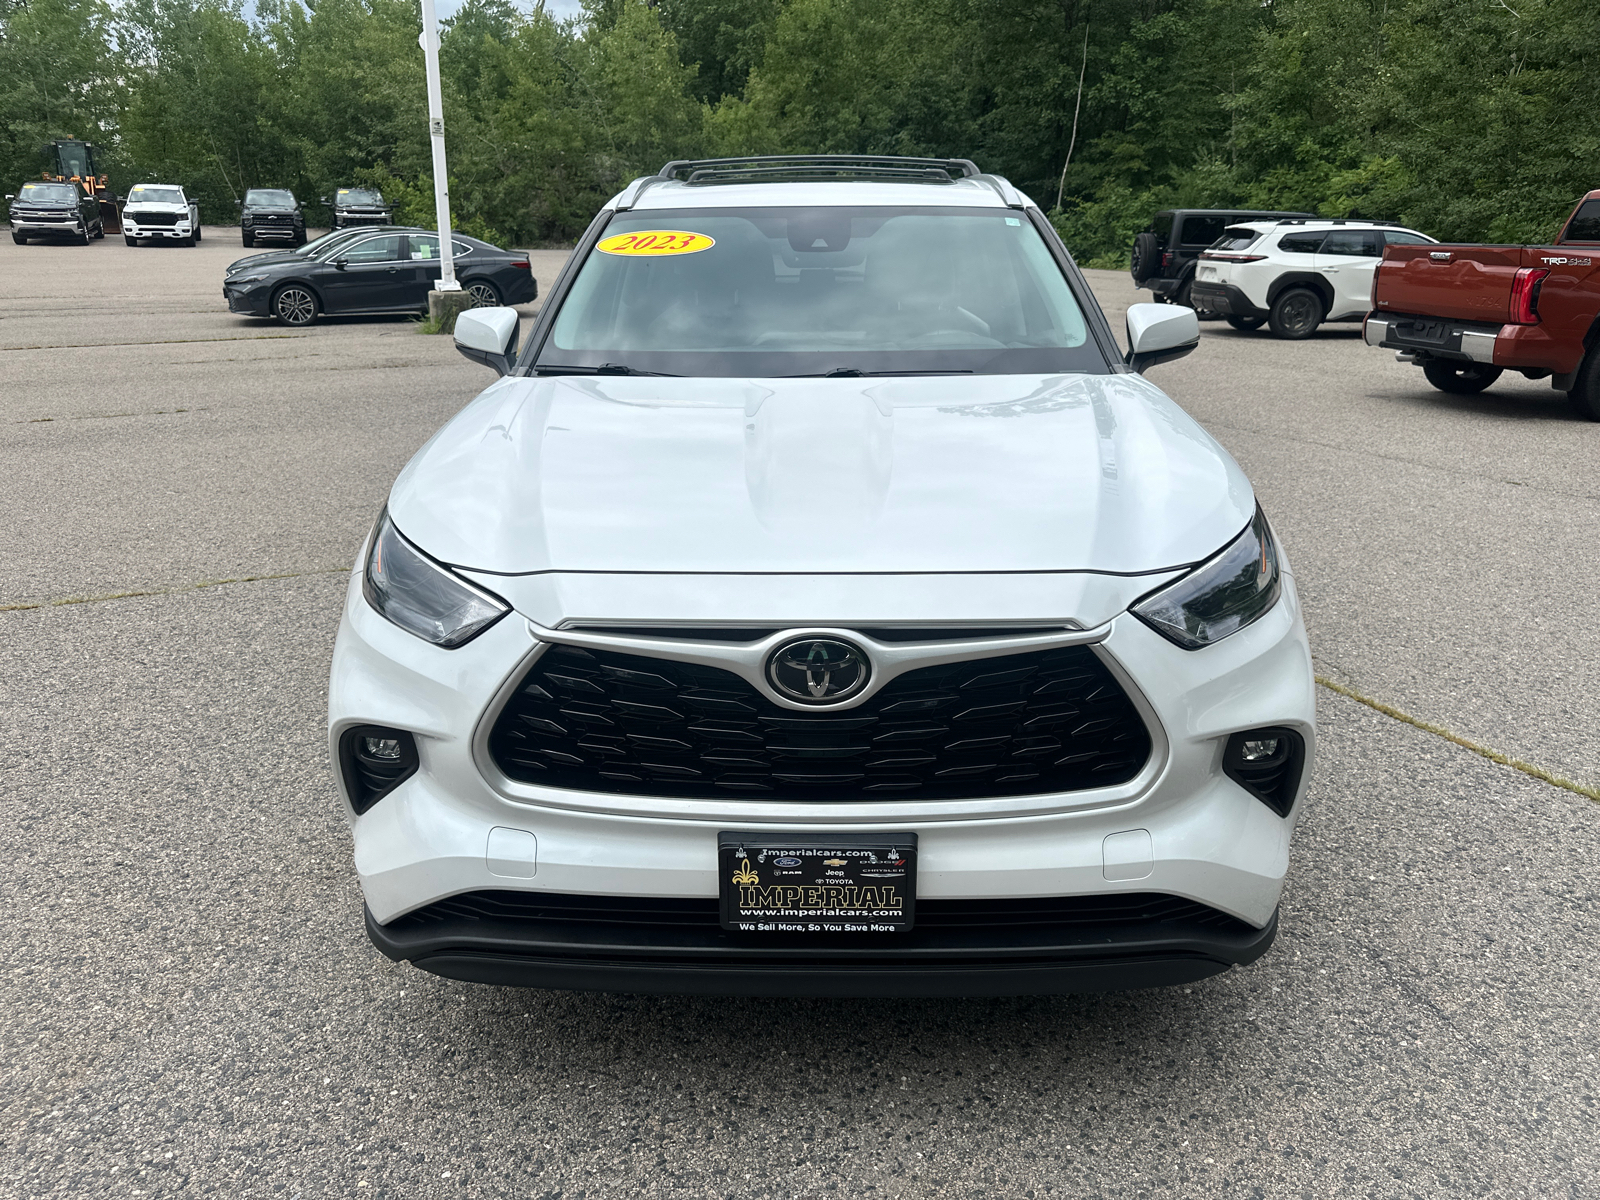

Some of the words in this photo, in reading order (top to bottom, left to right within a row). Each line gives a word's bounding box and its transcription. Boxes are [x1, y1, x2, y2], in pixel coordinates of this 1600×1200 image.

[611, 235, 696, 250] 2023
[1540, 257, 1568, 266] TRD
[762, 848, 873, 858] Imperialcars.com
[825, 869, 845, 877] Jeep
[739, 885, 903, 909] IMPERIAL
[739, 908, 903, 917] www.imperialcars.com
[739, 923, 756, 931] We
[757, 923, 776, 931] Sell
[778, 923, 806, 932] More,
[807, 923, 821, 931] So
[870, 924, 895, 932] More
